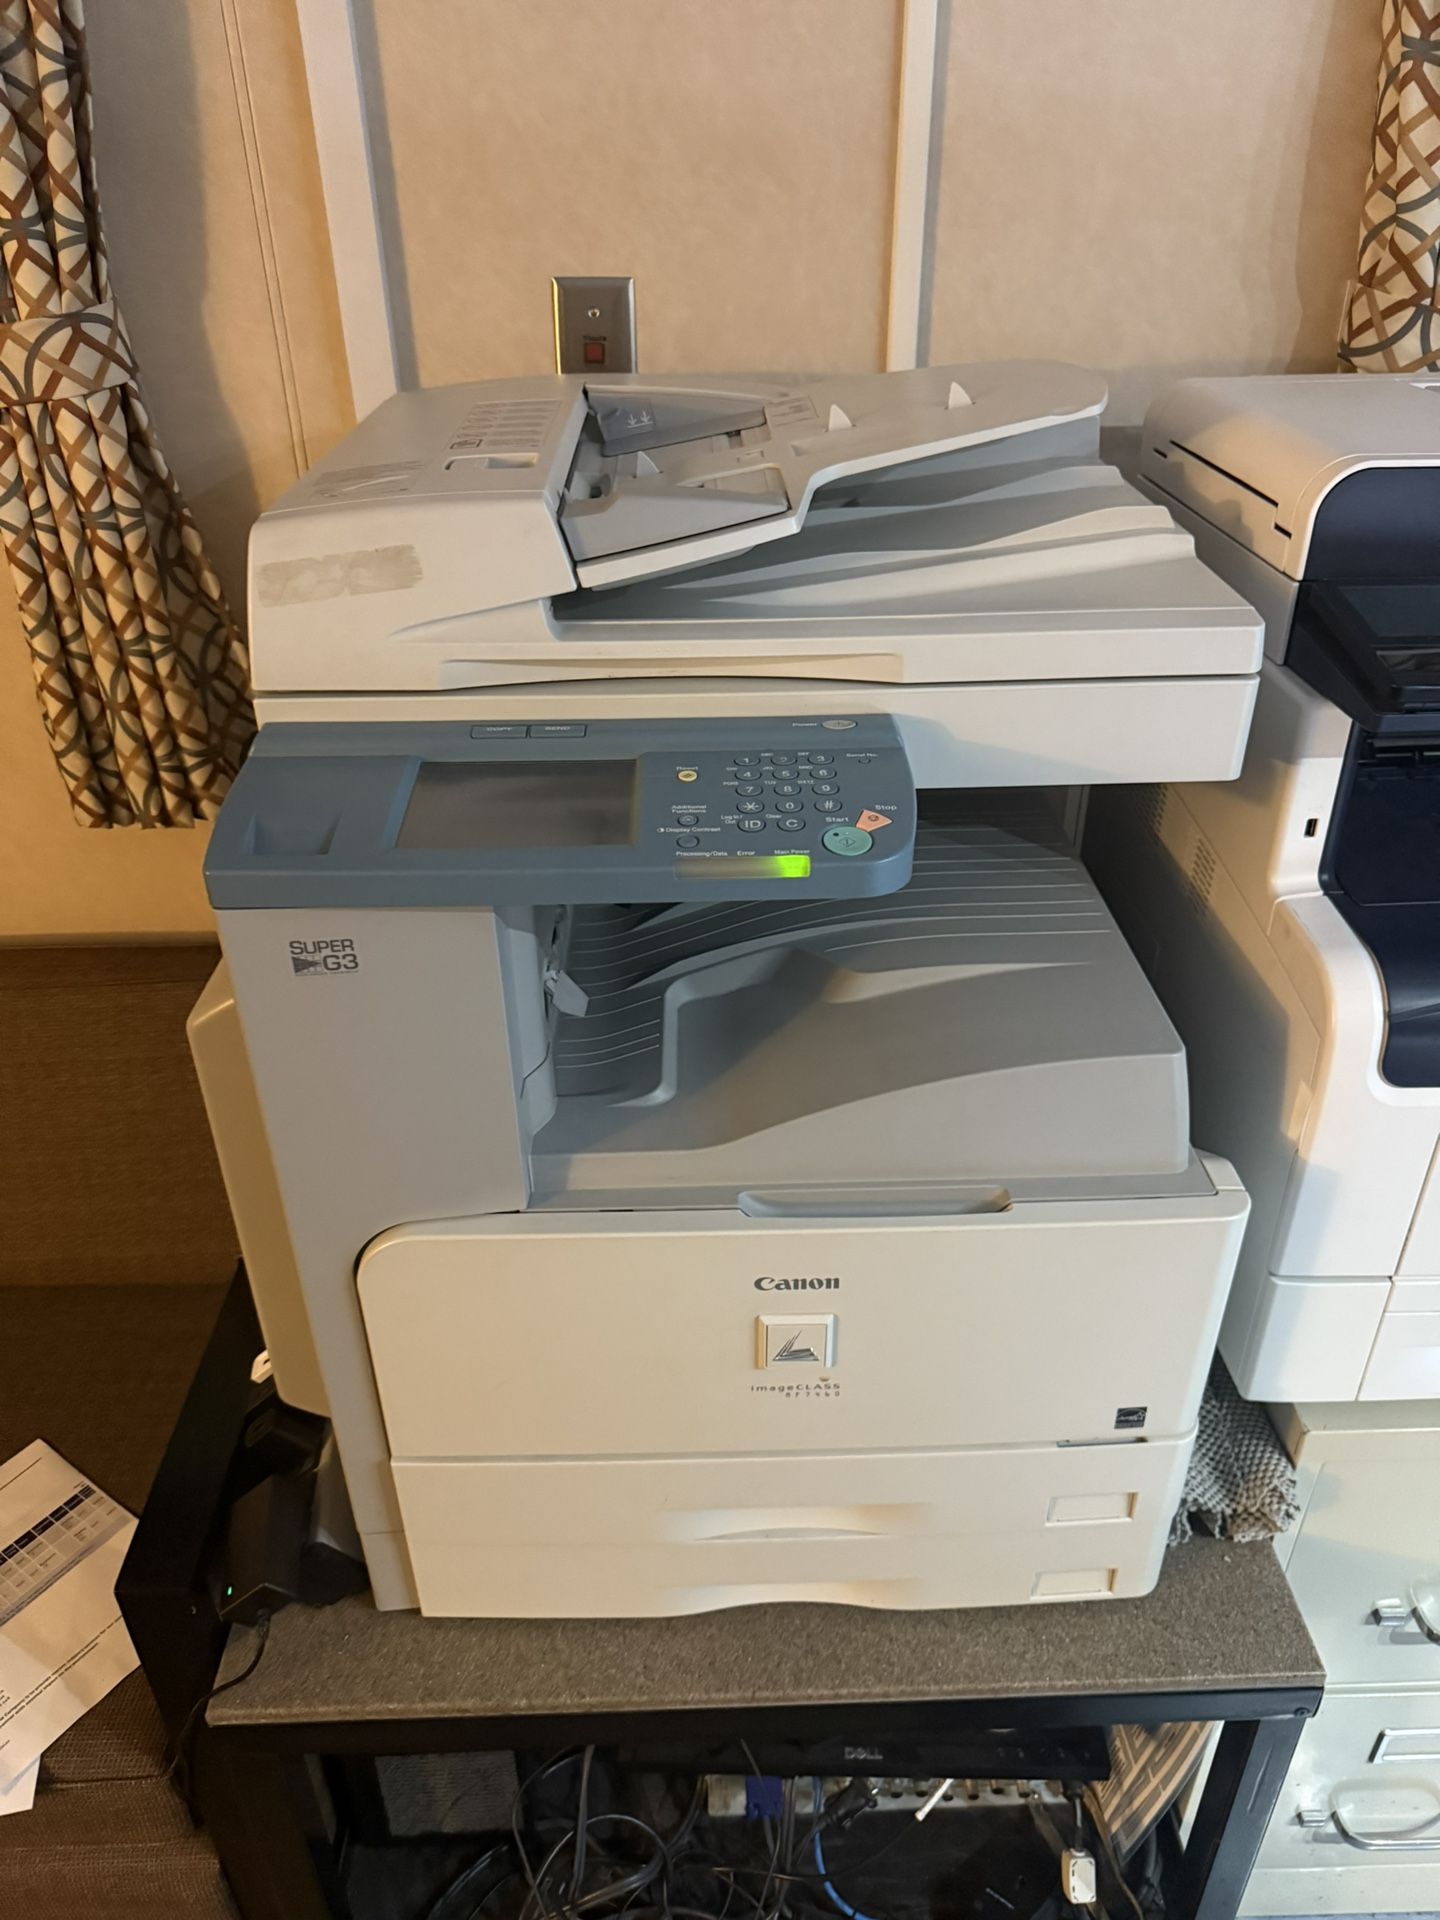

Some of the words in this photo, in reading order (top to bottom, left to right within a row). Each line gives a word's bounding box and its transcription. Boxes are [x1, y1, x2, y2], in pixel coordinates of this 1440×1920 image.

[821, 784, 831, 792] 9
[744, 820, 761, 828] ID
[786, 819, 798, 828] C
[289, 939, 354, 955] SUPER
[322, 953, 359, 971] G3
[754, 1276, 840, 1291] Canon
[751, 1383, 840, 1392] imageCLASS
